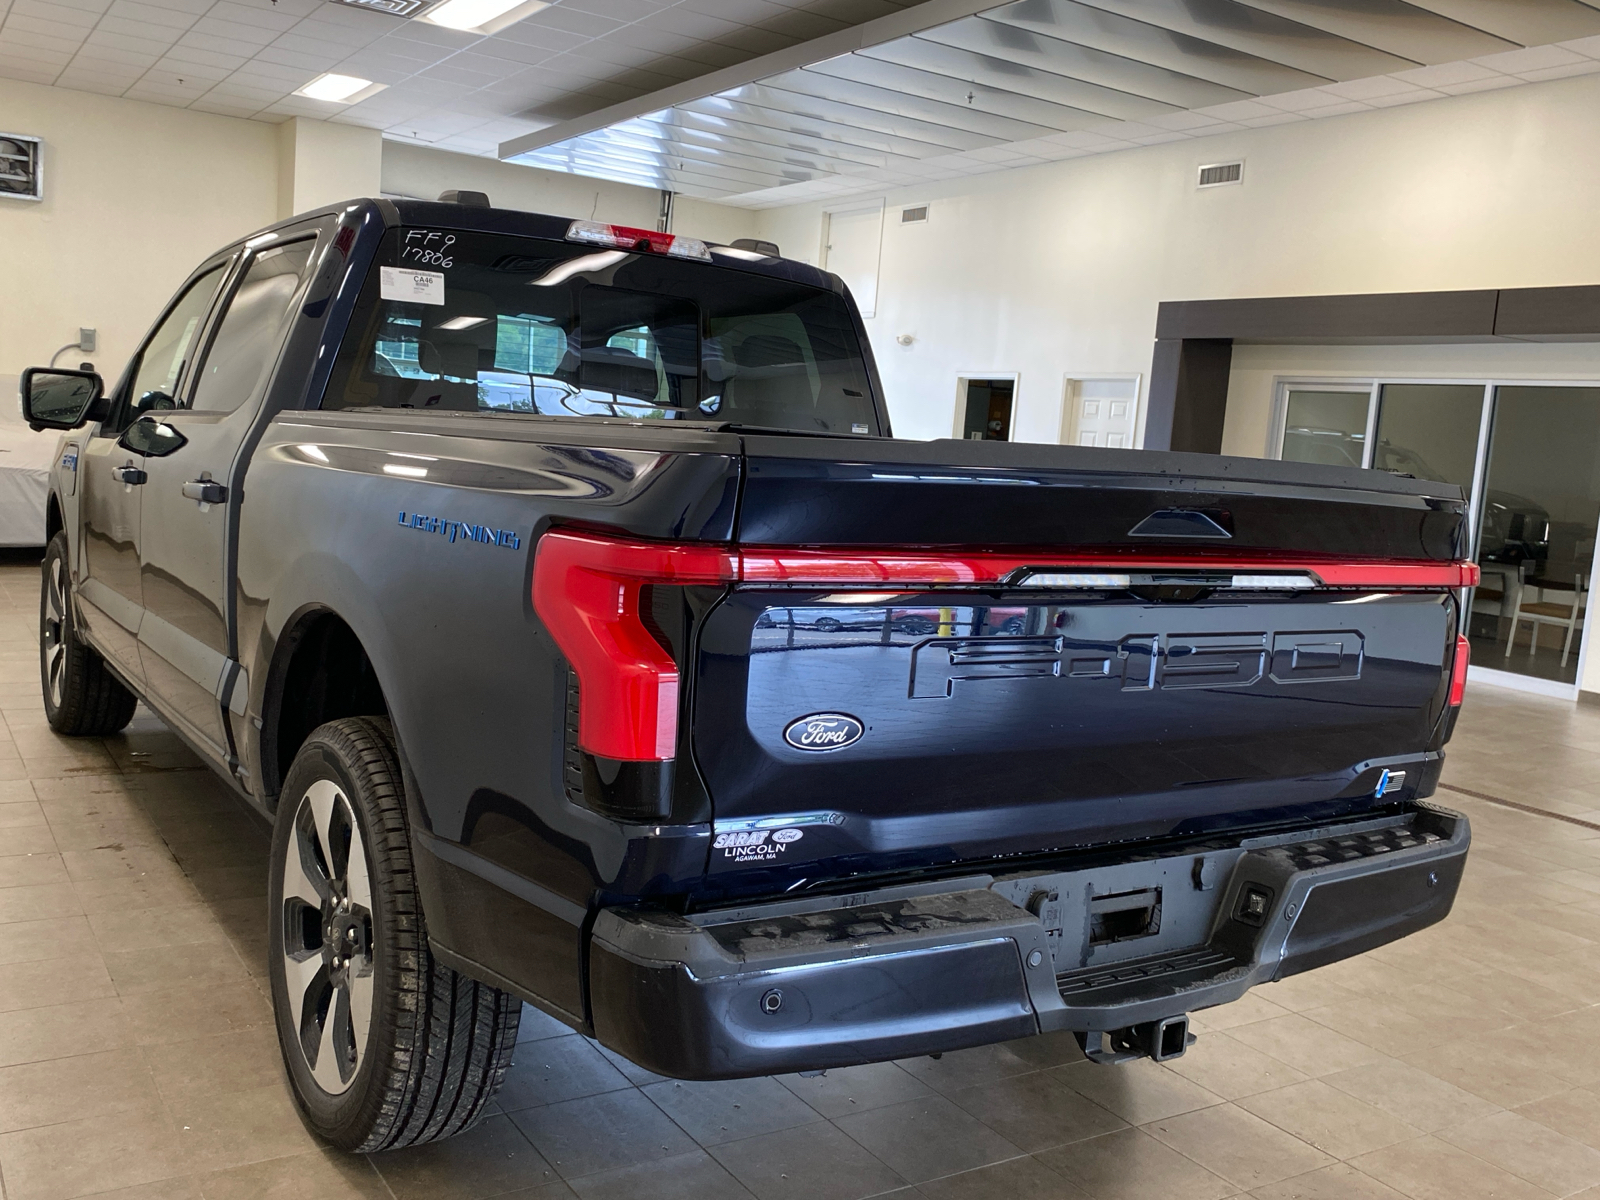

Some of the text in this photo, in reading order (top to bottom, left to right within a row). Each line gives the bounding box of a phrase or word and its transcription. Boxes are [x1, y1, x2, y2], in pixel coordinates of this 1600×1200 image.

[402, 246, 453, 268] 17806
[413, 275, 434, 284] CA46
[398, 511, 520, 550] LIGHTNING
[907, 629, 1366, 700] F-150
[801, 721, 849, 744] Ford
[713, 830, 800, 848] SARAT Ford
[724, 843, 786, 857] LINCOLN
[734, 854, 765, 862] AGAWAM,
